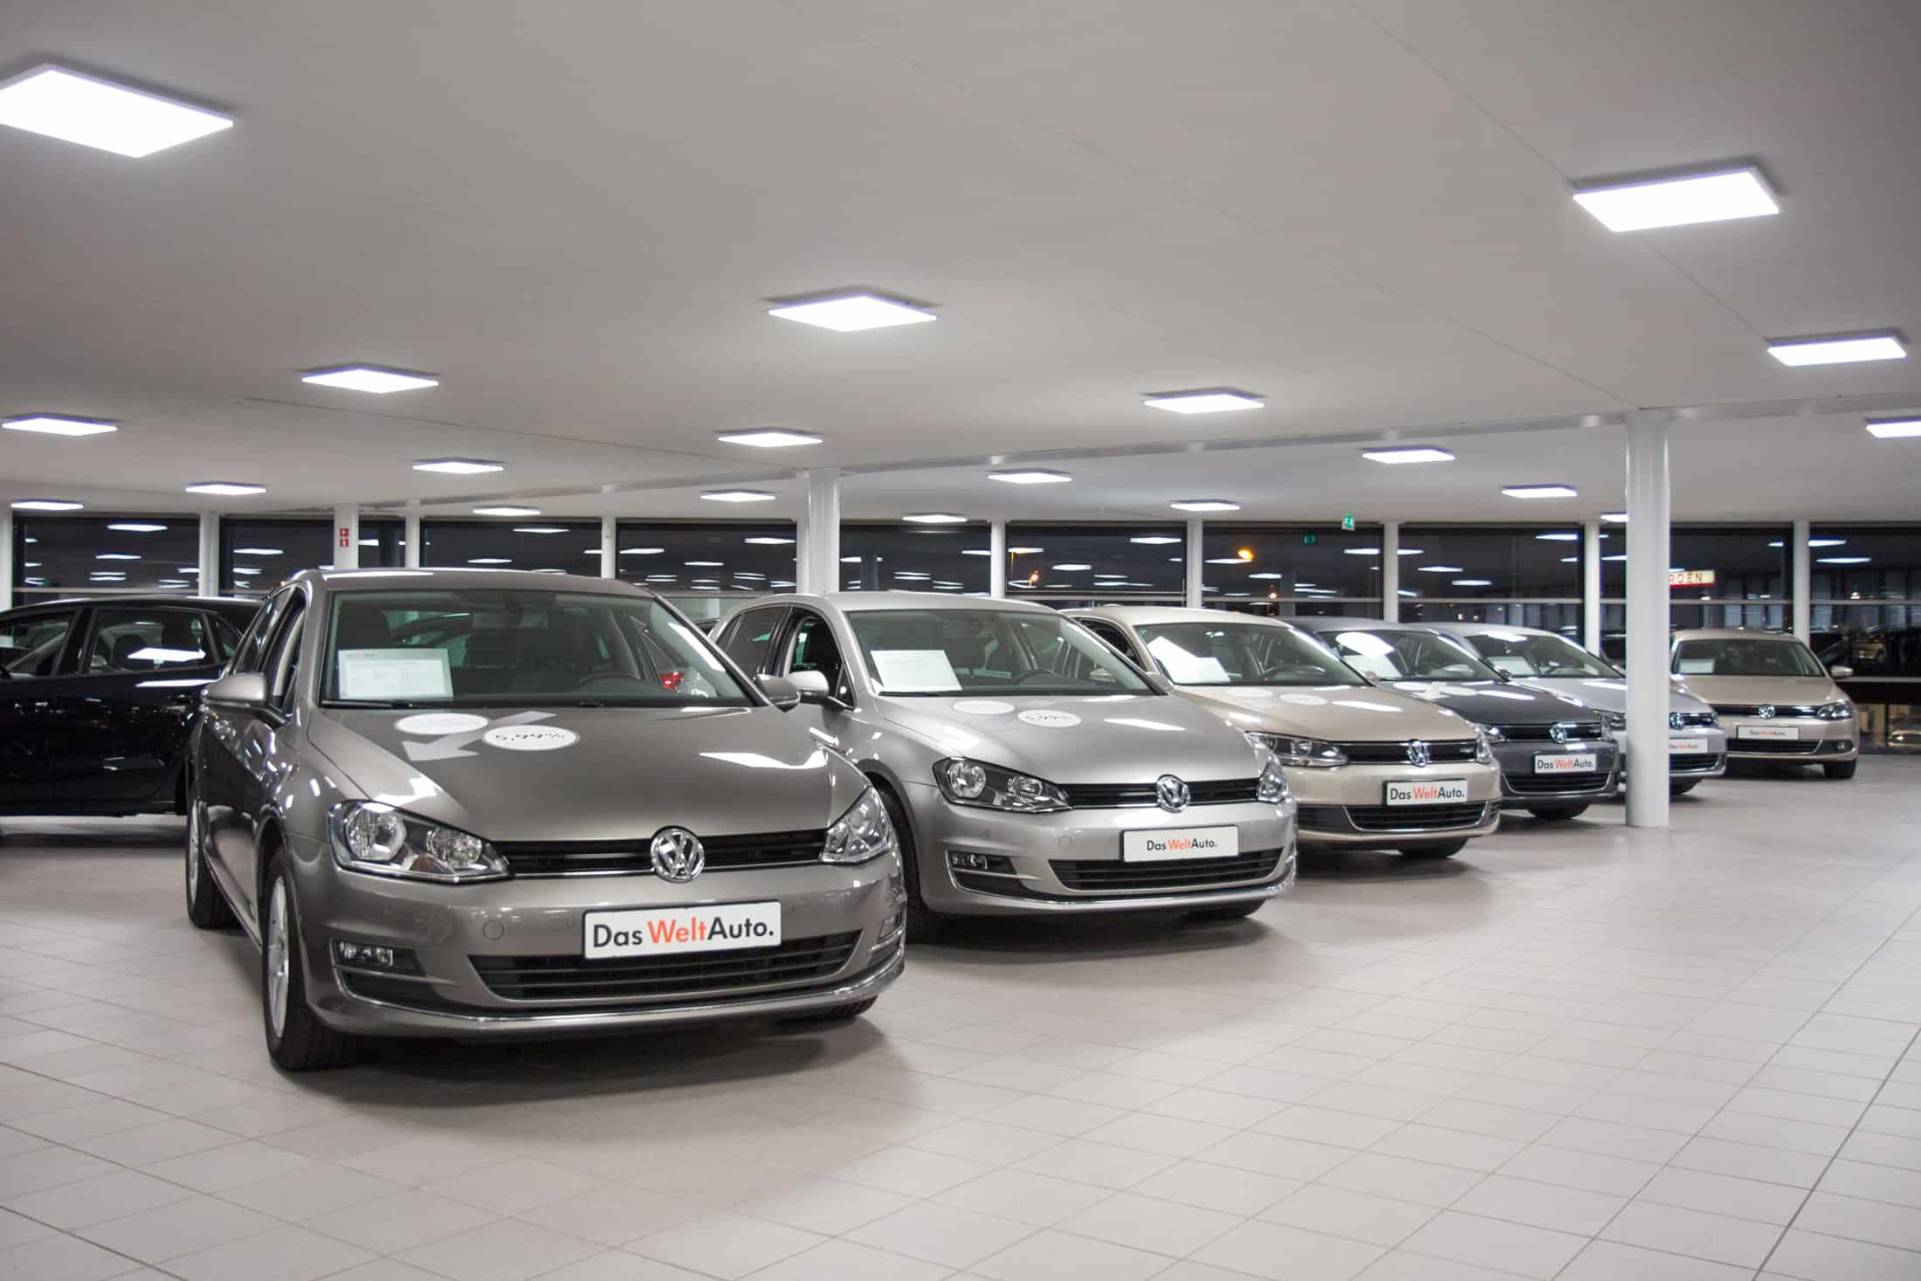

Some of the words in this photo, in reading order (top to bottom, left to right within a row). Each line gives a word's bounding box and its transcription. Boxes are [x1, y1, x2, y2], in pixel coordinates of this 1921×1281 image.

[1537, 759, 1553, 769] Das
[1390, 788, 1411, 800] Das
[1146, 840, 1167, 851] Das
[593, 923, 643, 948] Das
